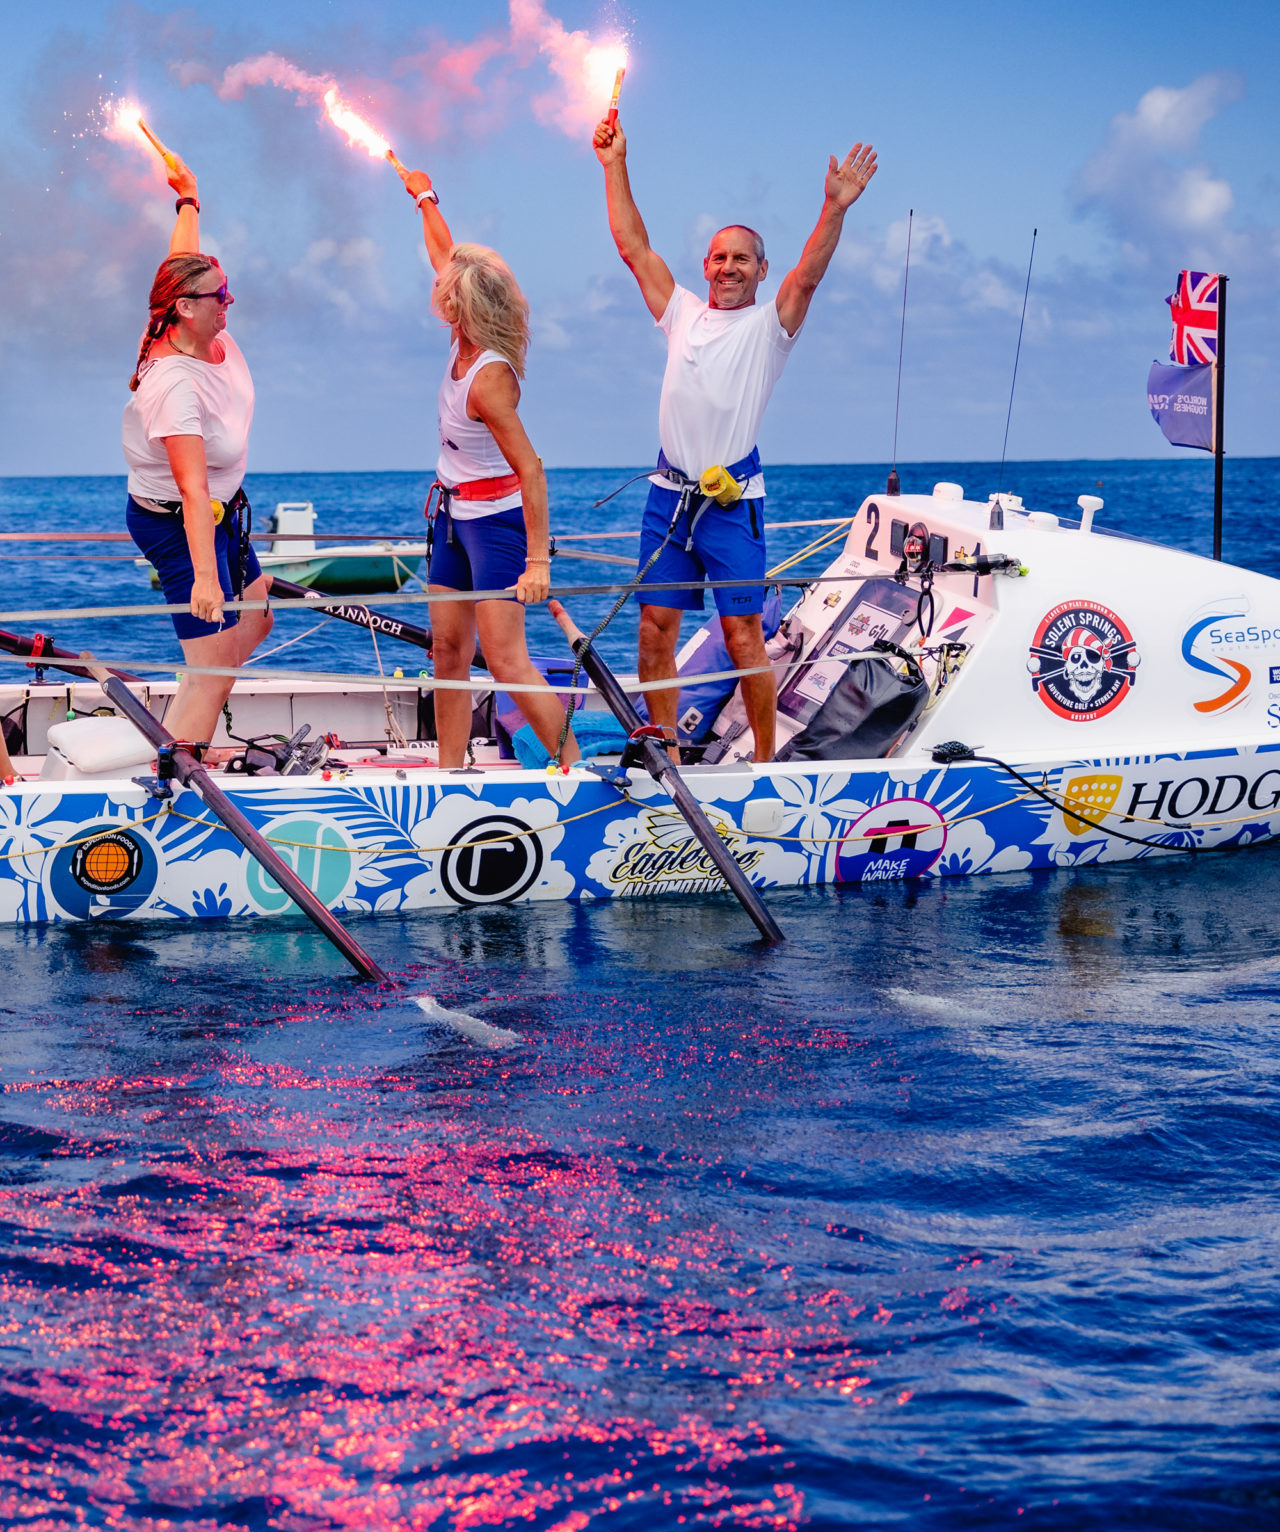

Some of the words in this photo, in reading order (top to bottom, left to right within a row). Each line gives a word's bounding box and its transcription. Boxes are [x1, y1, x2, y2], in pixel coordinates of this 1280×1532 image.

[865, 502, 880, 561] 2
[1048, 608, 1061, 620] LOVE
[1045, 614, 1077, 647] SOLENT
[1079, 612, 1122, 645] SPRINGS
[1048, 683, 1073, 708] ADVENTURE
[1074, 702, 1089, 710] GOLF
[1094, 690, 1114, 707] STOKES
[1111, 679, 1121, 692] BAY
[1071, 712, 1097, 720] GOSPORT
[1120, 769, 1280, 823] HODG
[117, 834, 135, 850] FOODS
[864, 858, 910, 872] MAKE
